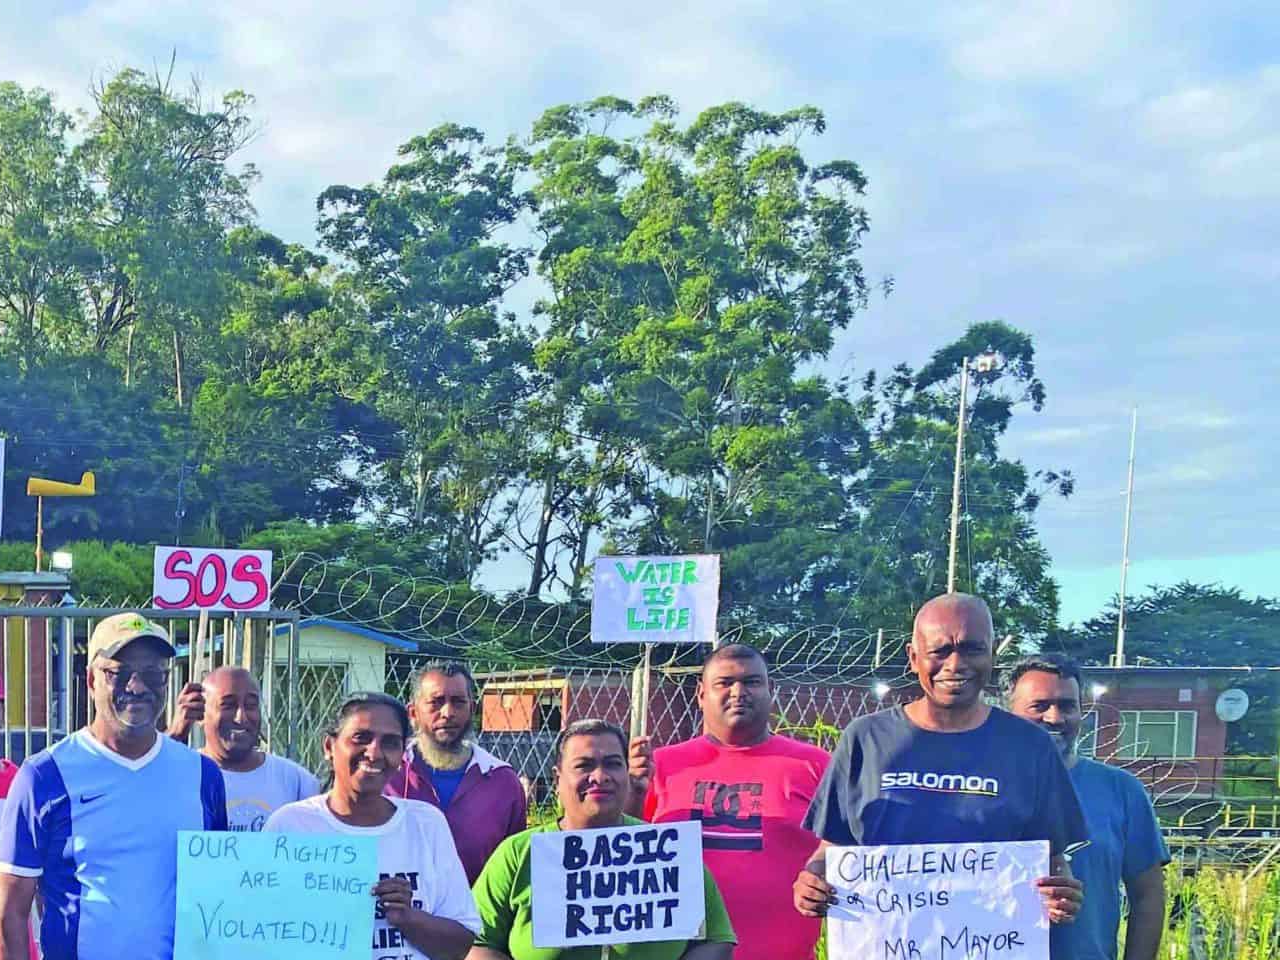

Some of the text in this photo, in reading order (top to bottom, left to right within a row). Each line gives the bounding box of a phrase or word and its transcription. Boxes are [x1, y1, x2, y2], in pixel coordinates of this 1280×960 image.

[153, 550, 269, 609] SOS
[616, 560, 698, 584] WATER
[642, 586, 675, 606] IS
[627, 608, 689, 631] LIFE
[188, 835, 358, 864] OUR RIGHTS
[562, 828, 679, 871] BASIC
[837, 847, 998, 883] CHALLENGE
[240, 871, 281, 888] ARE
[304, 872, 369, 895] BEING
[565, 866, 680, 901] HUMAN
[876, 888, 950, 915] CRISIS
[565, 898, 680, 938] RIGHT
